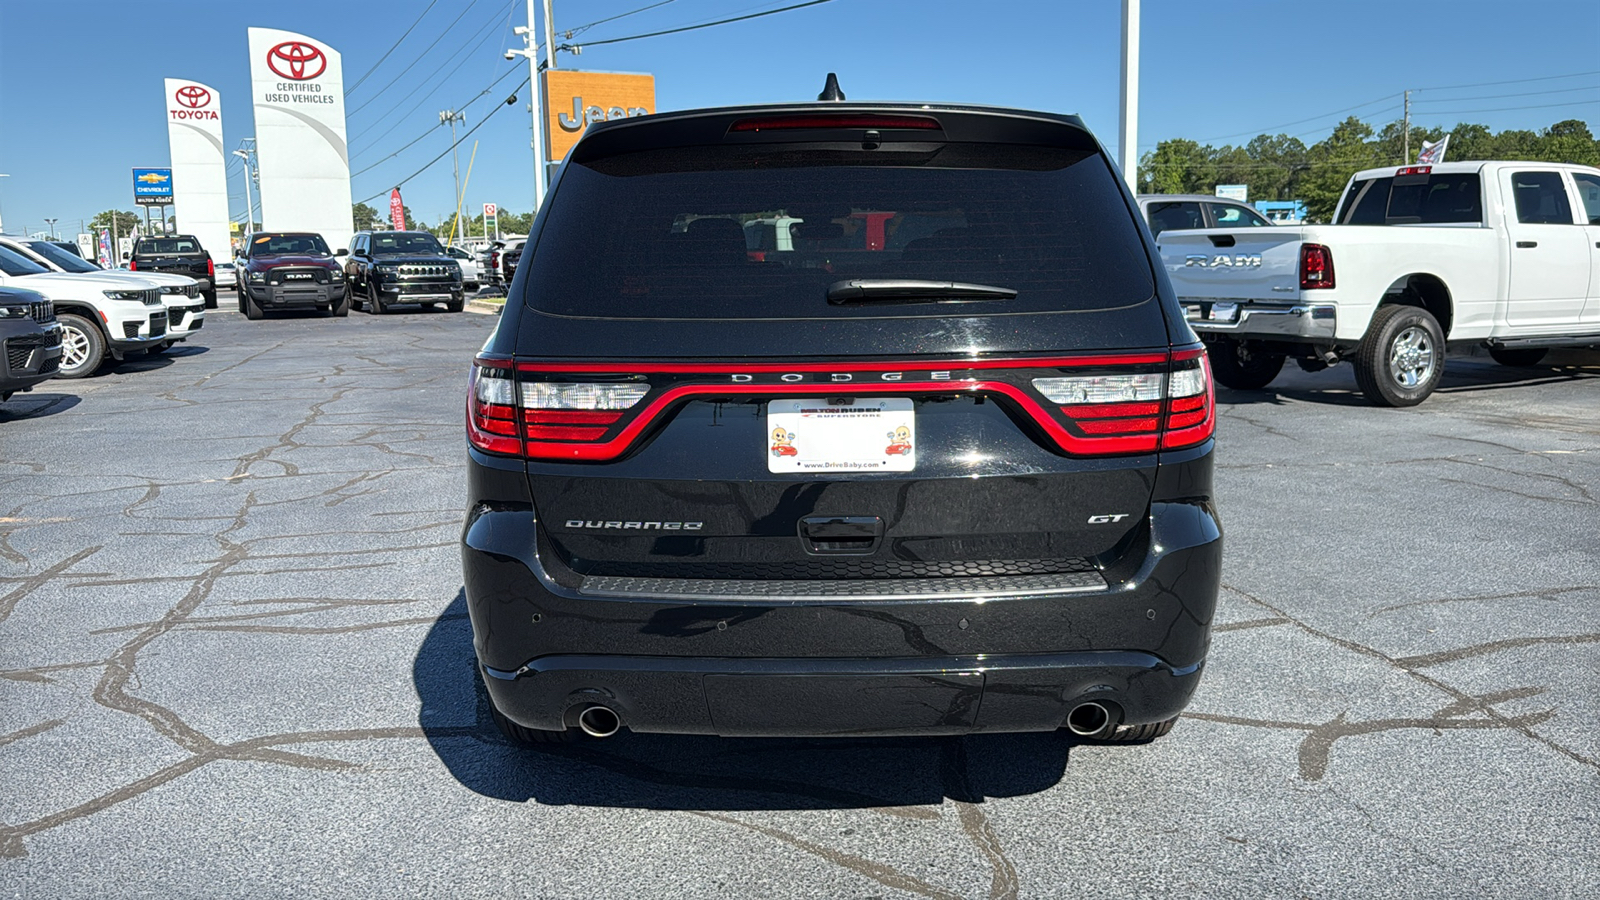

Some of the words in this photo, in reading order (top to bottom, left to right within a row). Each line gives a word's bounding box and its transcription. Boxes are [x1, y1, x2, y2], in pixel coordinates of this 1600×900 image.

[276, 82, 322, 93] CERTIFIED
[265, 93, 290, 103] USED
[291, 94, 334, 104] VEHICLES
[170, 110, 219, 120] TOYOTA
[1185, 253, 1263, 268] RAM
[731, 371, 951, 382] DODGE
[803, 461, 880, 469] www.DriveBaby.com
[1087, 513, 1130, 524] GT
[565, 519, 704, 531] DURANGO
